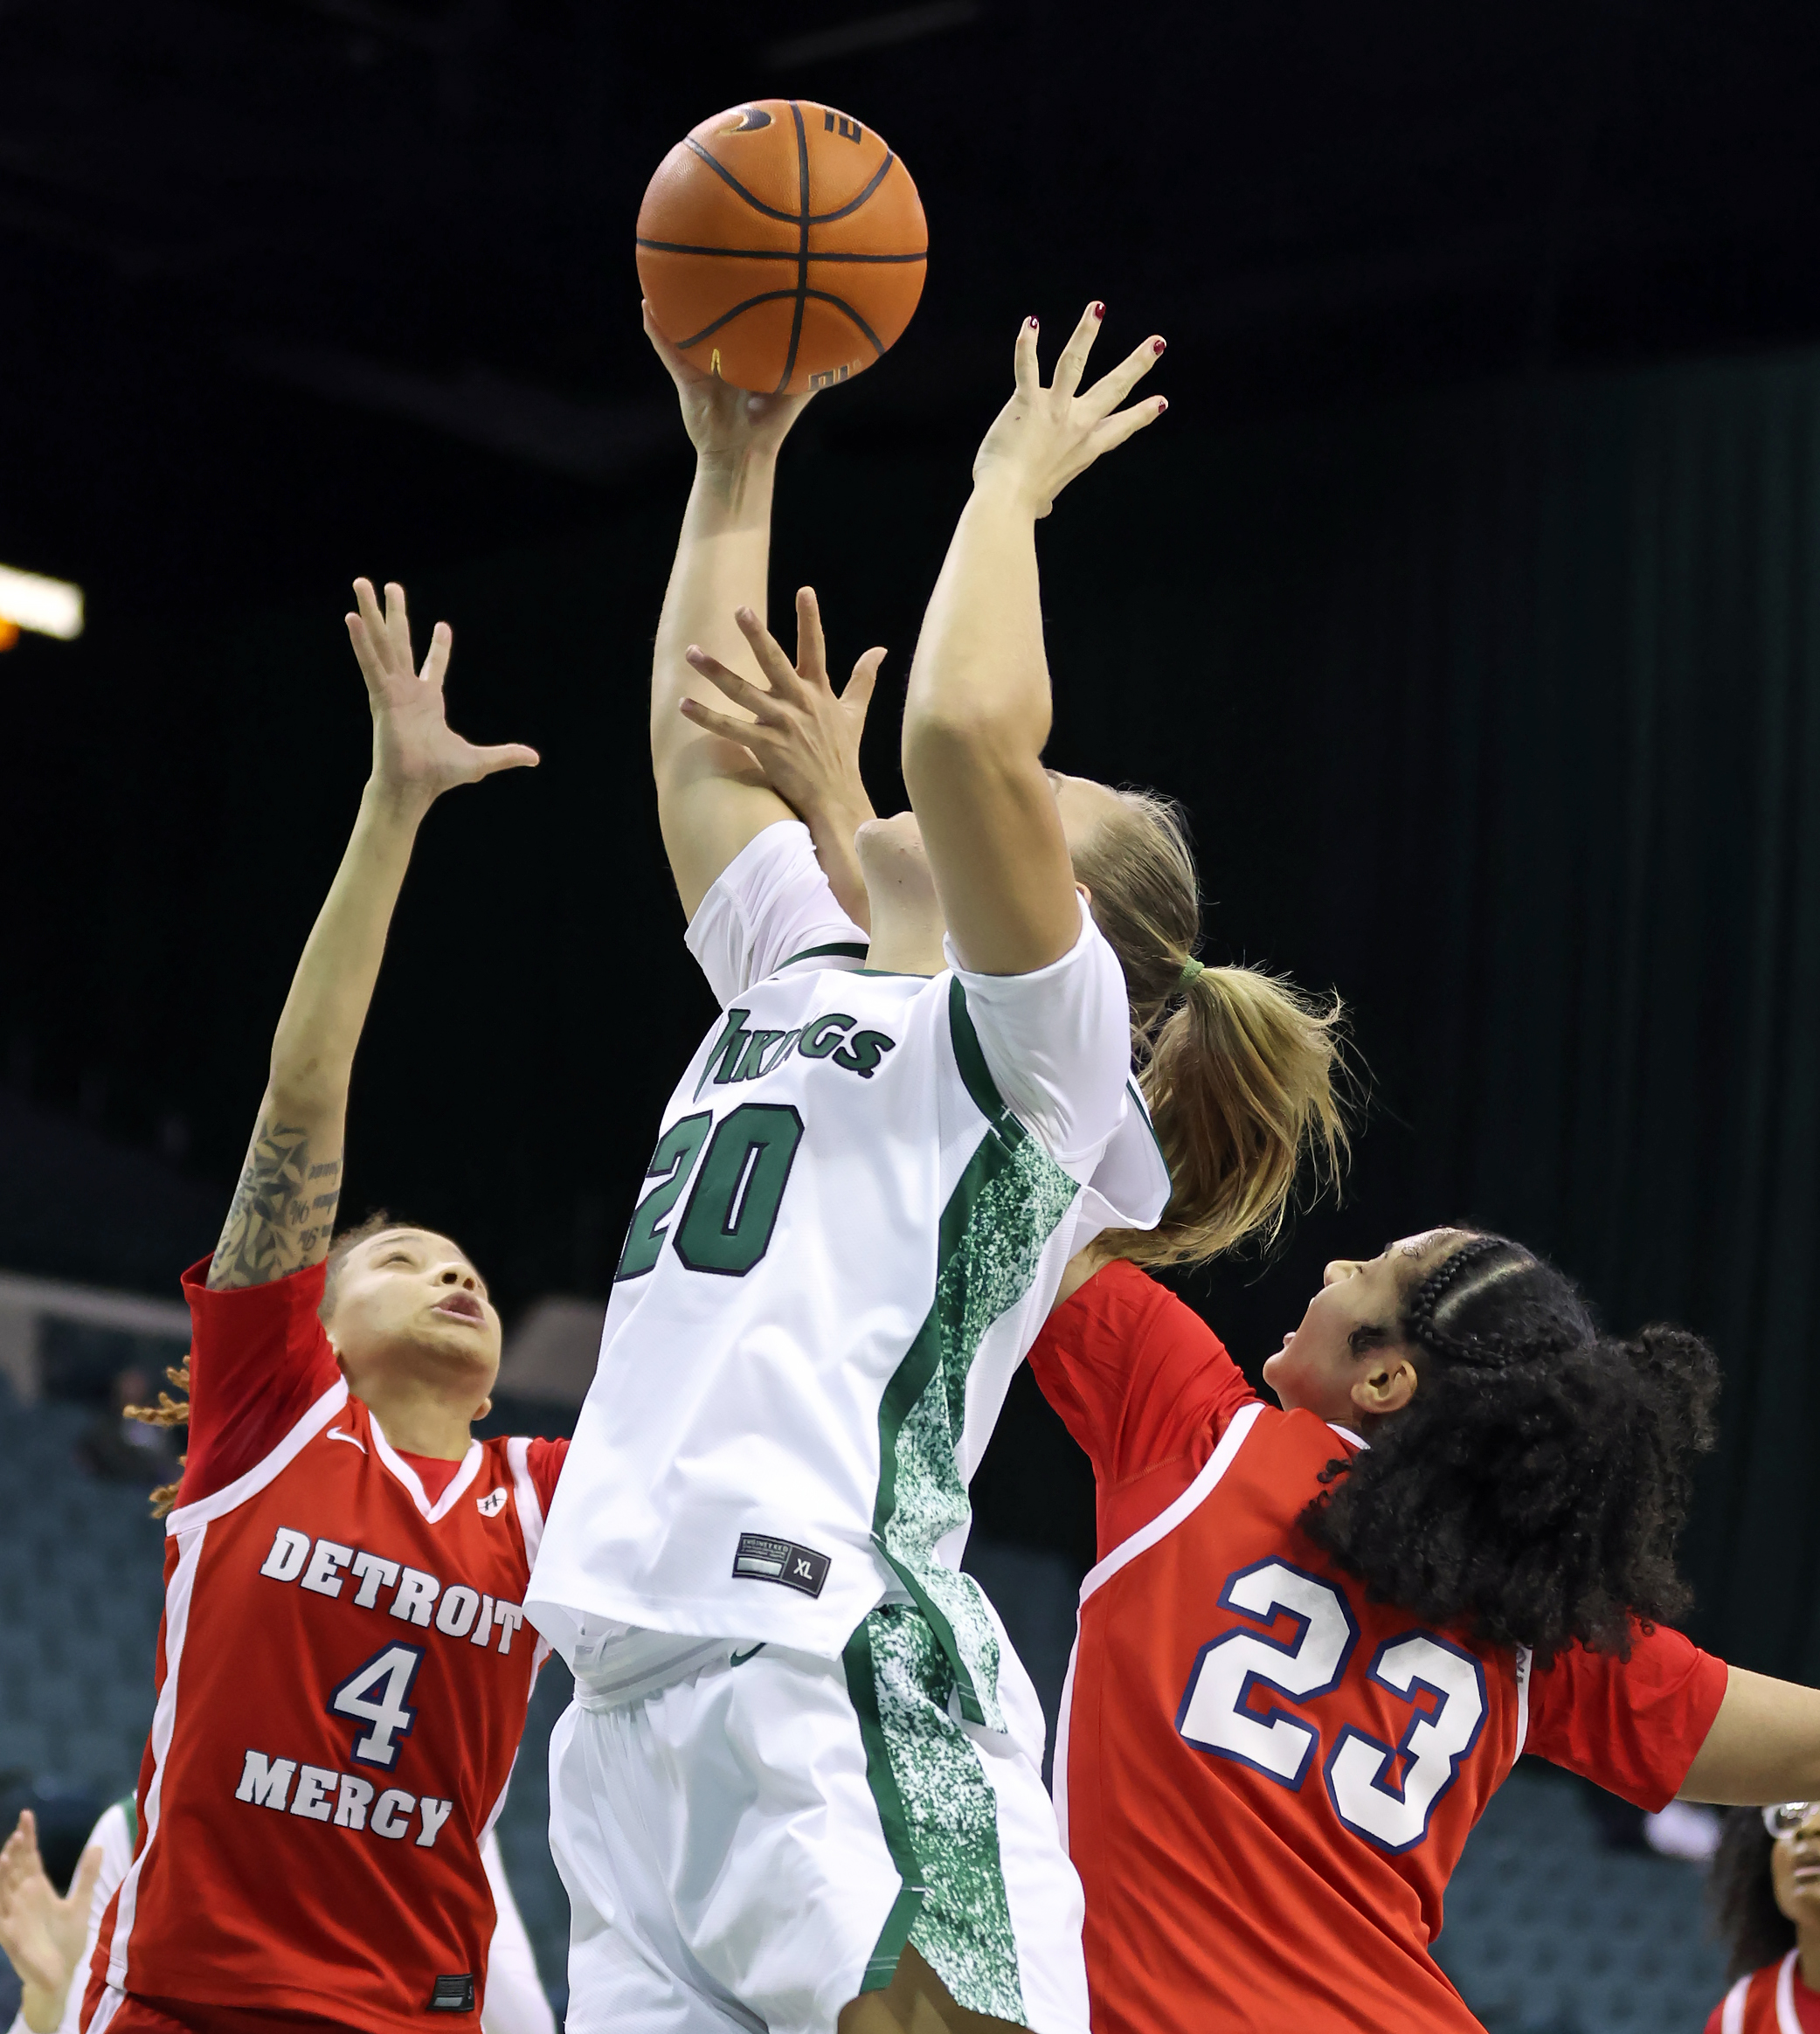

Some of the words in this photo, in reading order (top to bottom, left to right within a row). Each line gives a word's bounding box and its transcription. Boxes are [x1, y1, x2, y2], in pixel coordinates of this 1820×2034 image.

[693, 1008, 896, 1103] VIKIGS
[613, 1103, 806, 1283] 20
[260, 1526, 524, 1655] DETROIT
[793, 1558, 813, 1581] XL
[326, 1639, 426, 1773] 4
[1174, 1554, 1489, 1856] 23
[234, 1749, 453, 1848] MERCY
